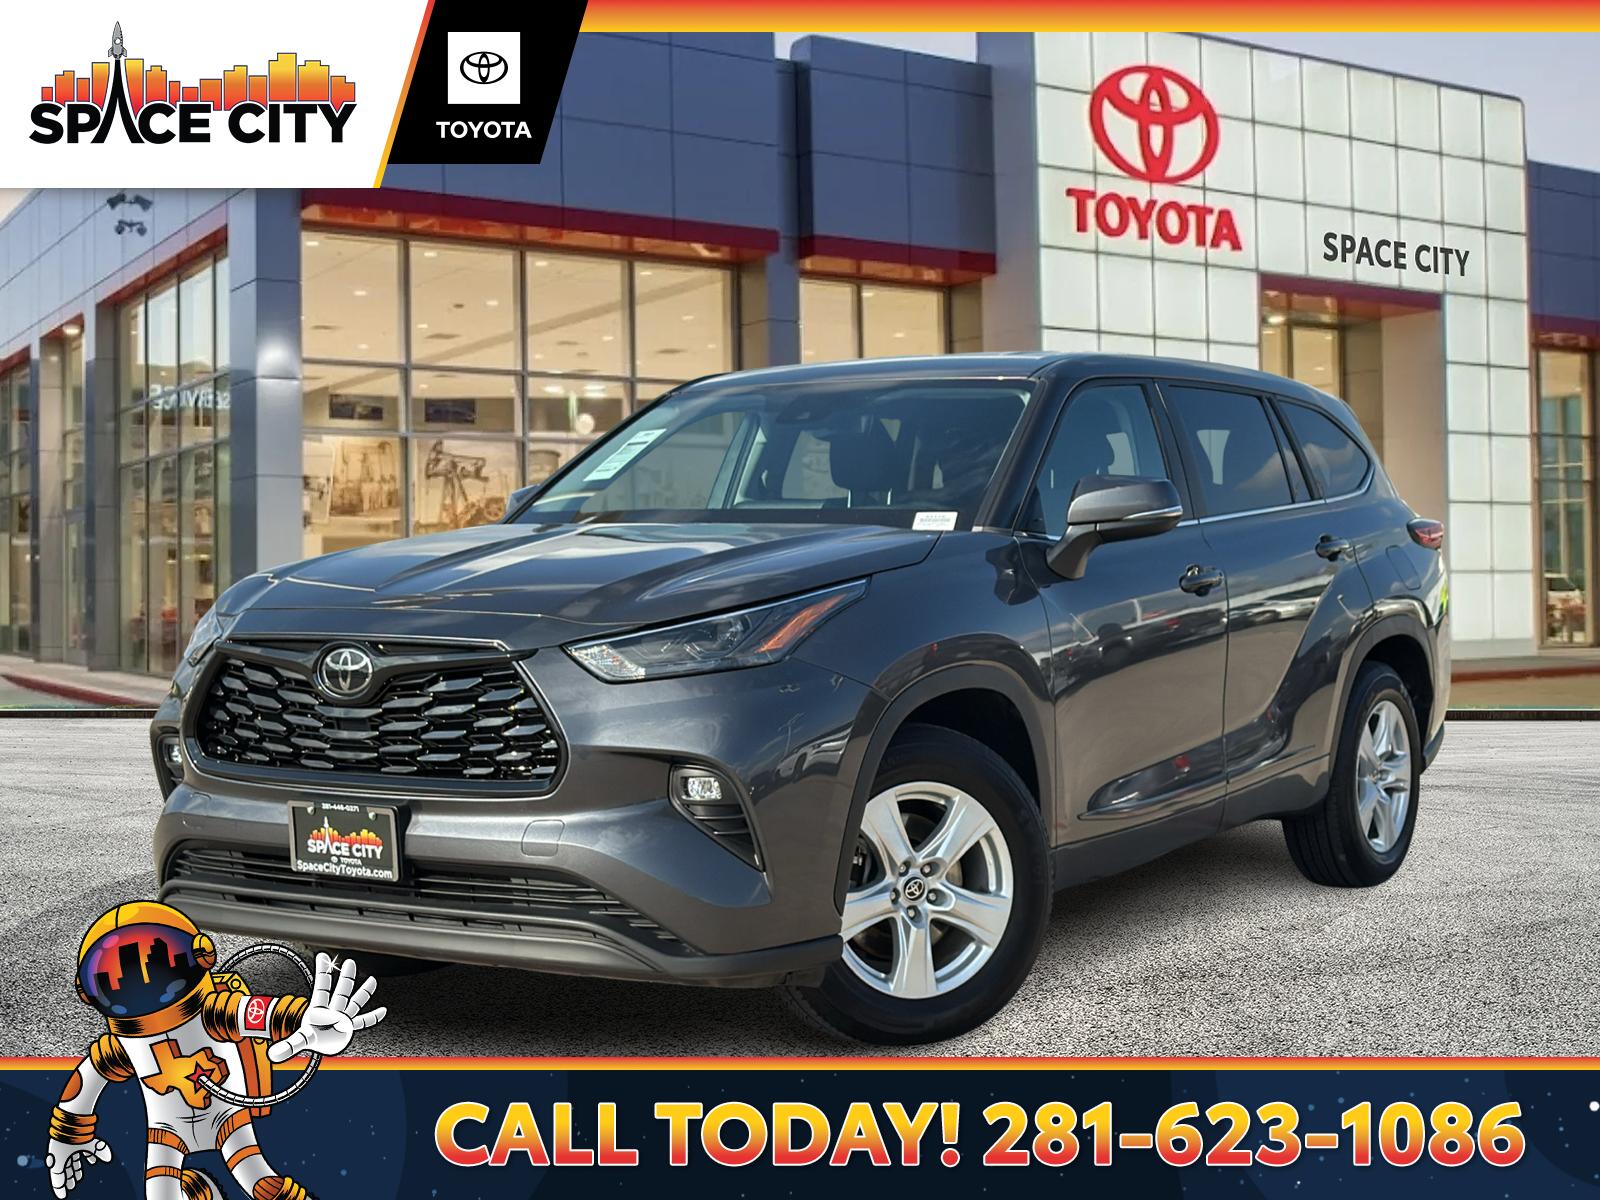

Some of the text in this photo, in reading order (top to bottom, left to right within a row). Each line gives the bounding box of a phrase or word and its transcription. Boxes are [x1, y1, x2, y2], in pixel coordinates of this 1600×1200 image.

[1066, 188, 1242, 251] TOYOTA
[1323, 232, 1470, 277] SPACE CITY
[352, 843, 384, 860] CITY
[297, 860, 392, 878] SpaceCityToyota.com
[340, 857, 362, 865] TOYOTA
